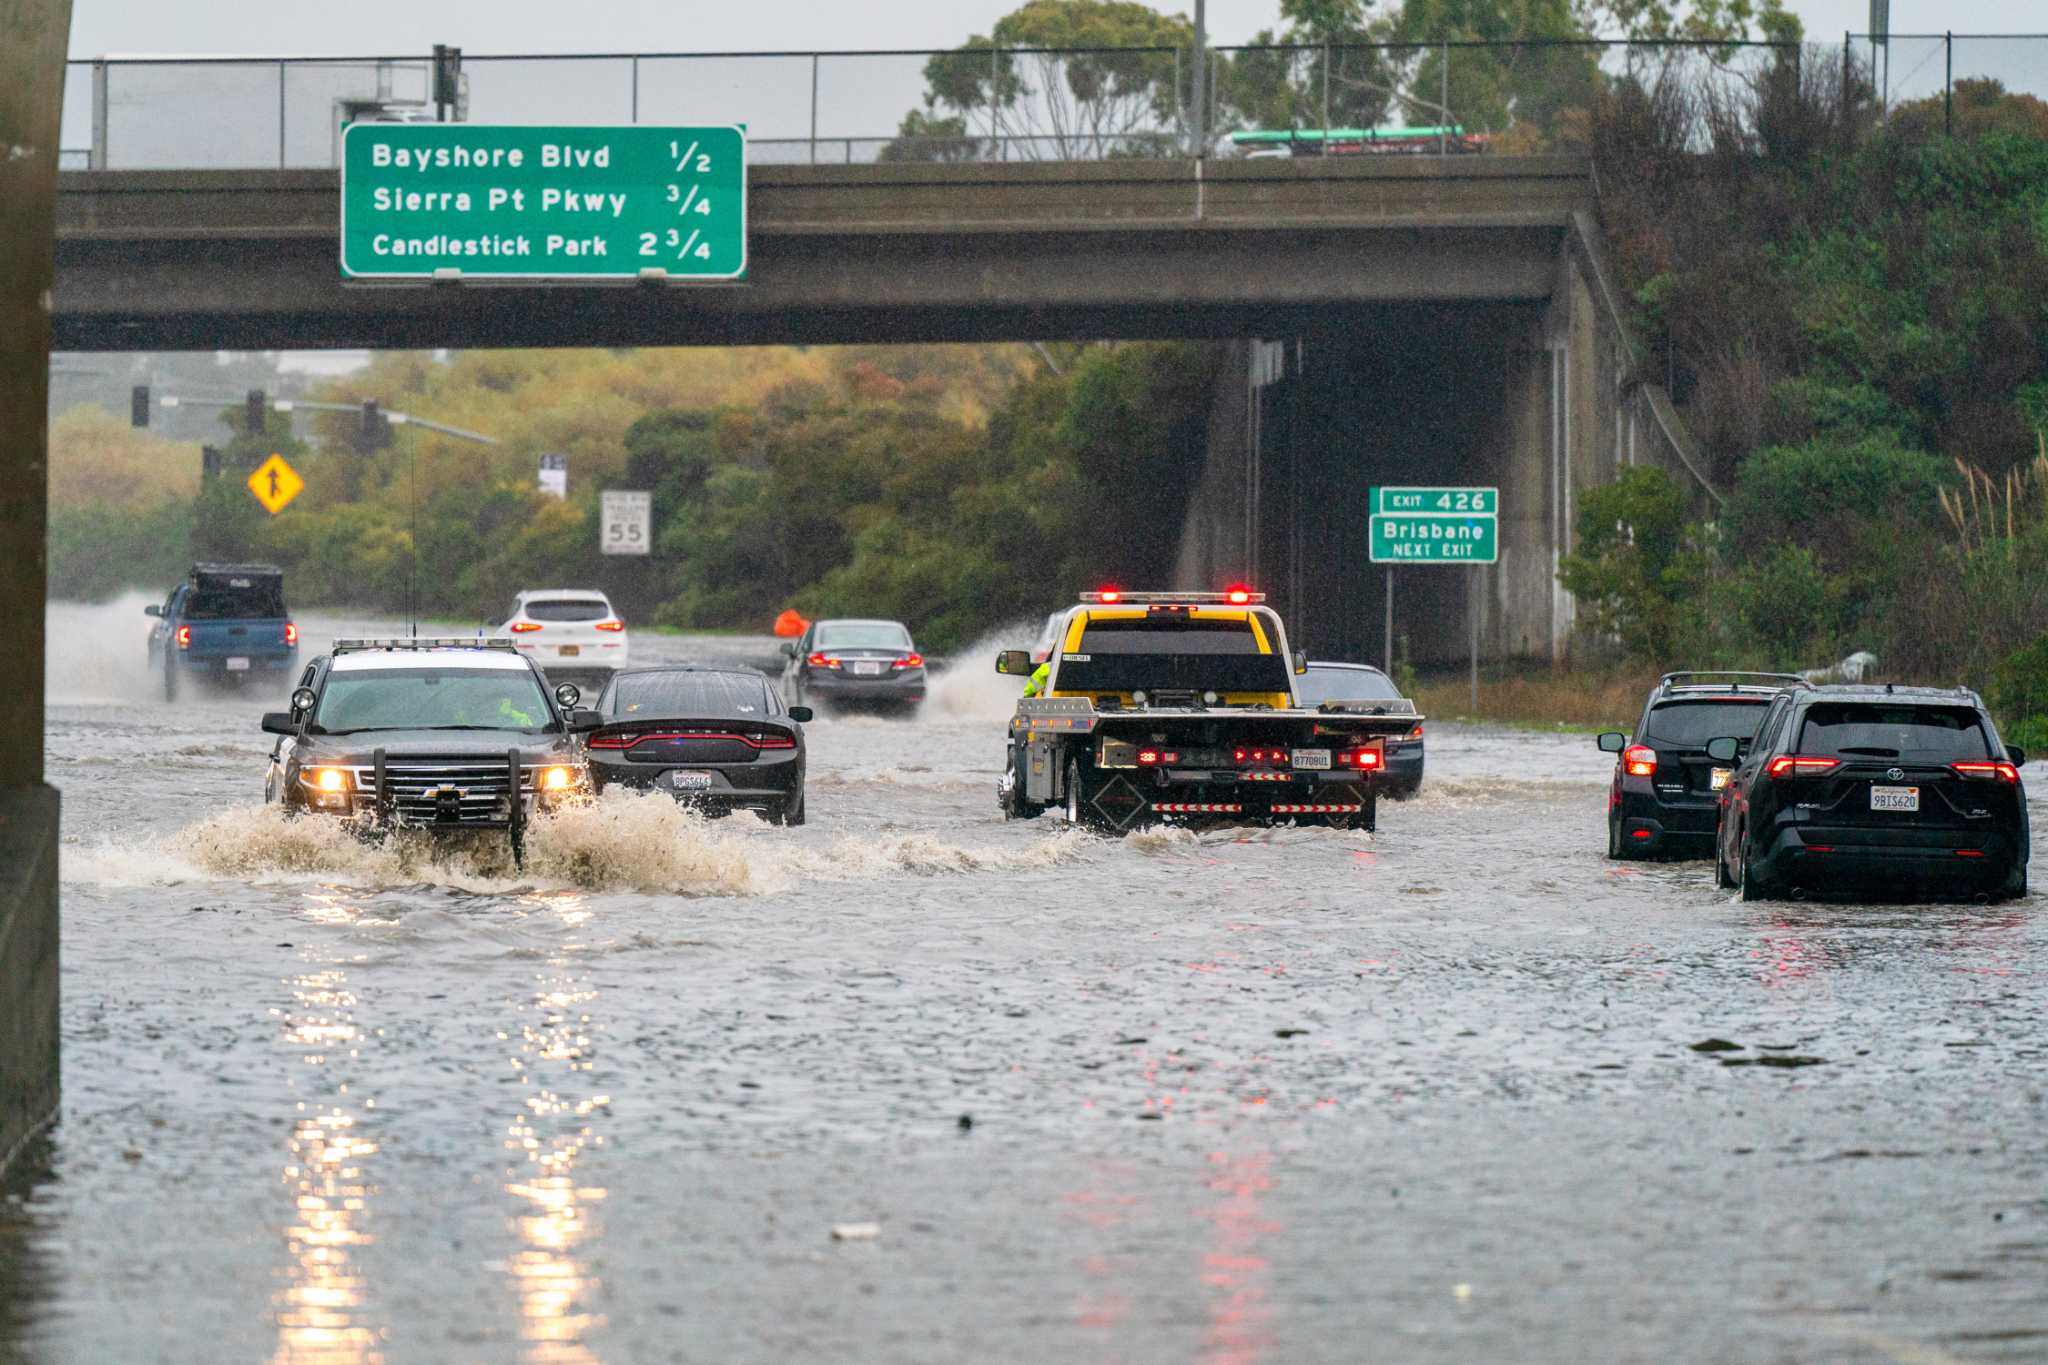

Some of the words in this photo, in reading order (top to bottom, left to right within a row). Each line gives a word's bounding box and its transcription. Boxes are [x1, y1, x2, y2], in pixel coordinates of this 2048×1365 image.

[373, 144, 523, 171] Bayshore
[542, 145, 609, 167] Blvd
[374, 188, 470, 211] Sierra
[489, 188, 524, 211] Pt
[543, 188, 626, 216] Pkwy
[373, 235, 529, 255] Candlestick
[547, 235, 607, 255] Park
[1393, 496, 1421, 506] EXIT
[1437, 494, 1484, 510] 426
[610, 524, 641, 541] 55
[1384, 522, 1483, 539] Brisbane
[1393, 544, 1431, 556] NEXT
[1442, 544, 1472, 556] EXIT
[1874, 795, 1916, 808] 9BIS620
